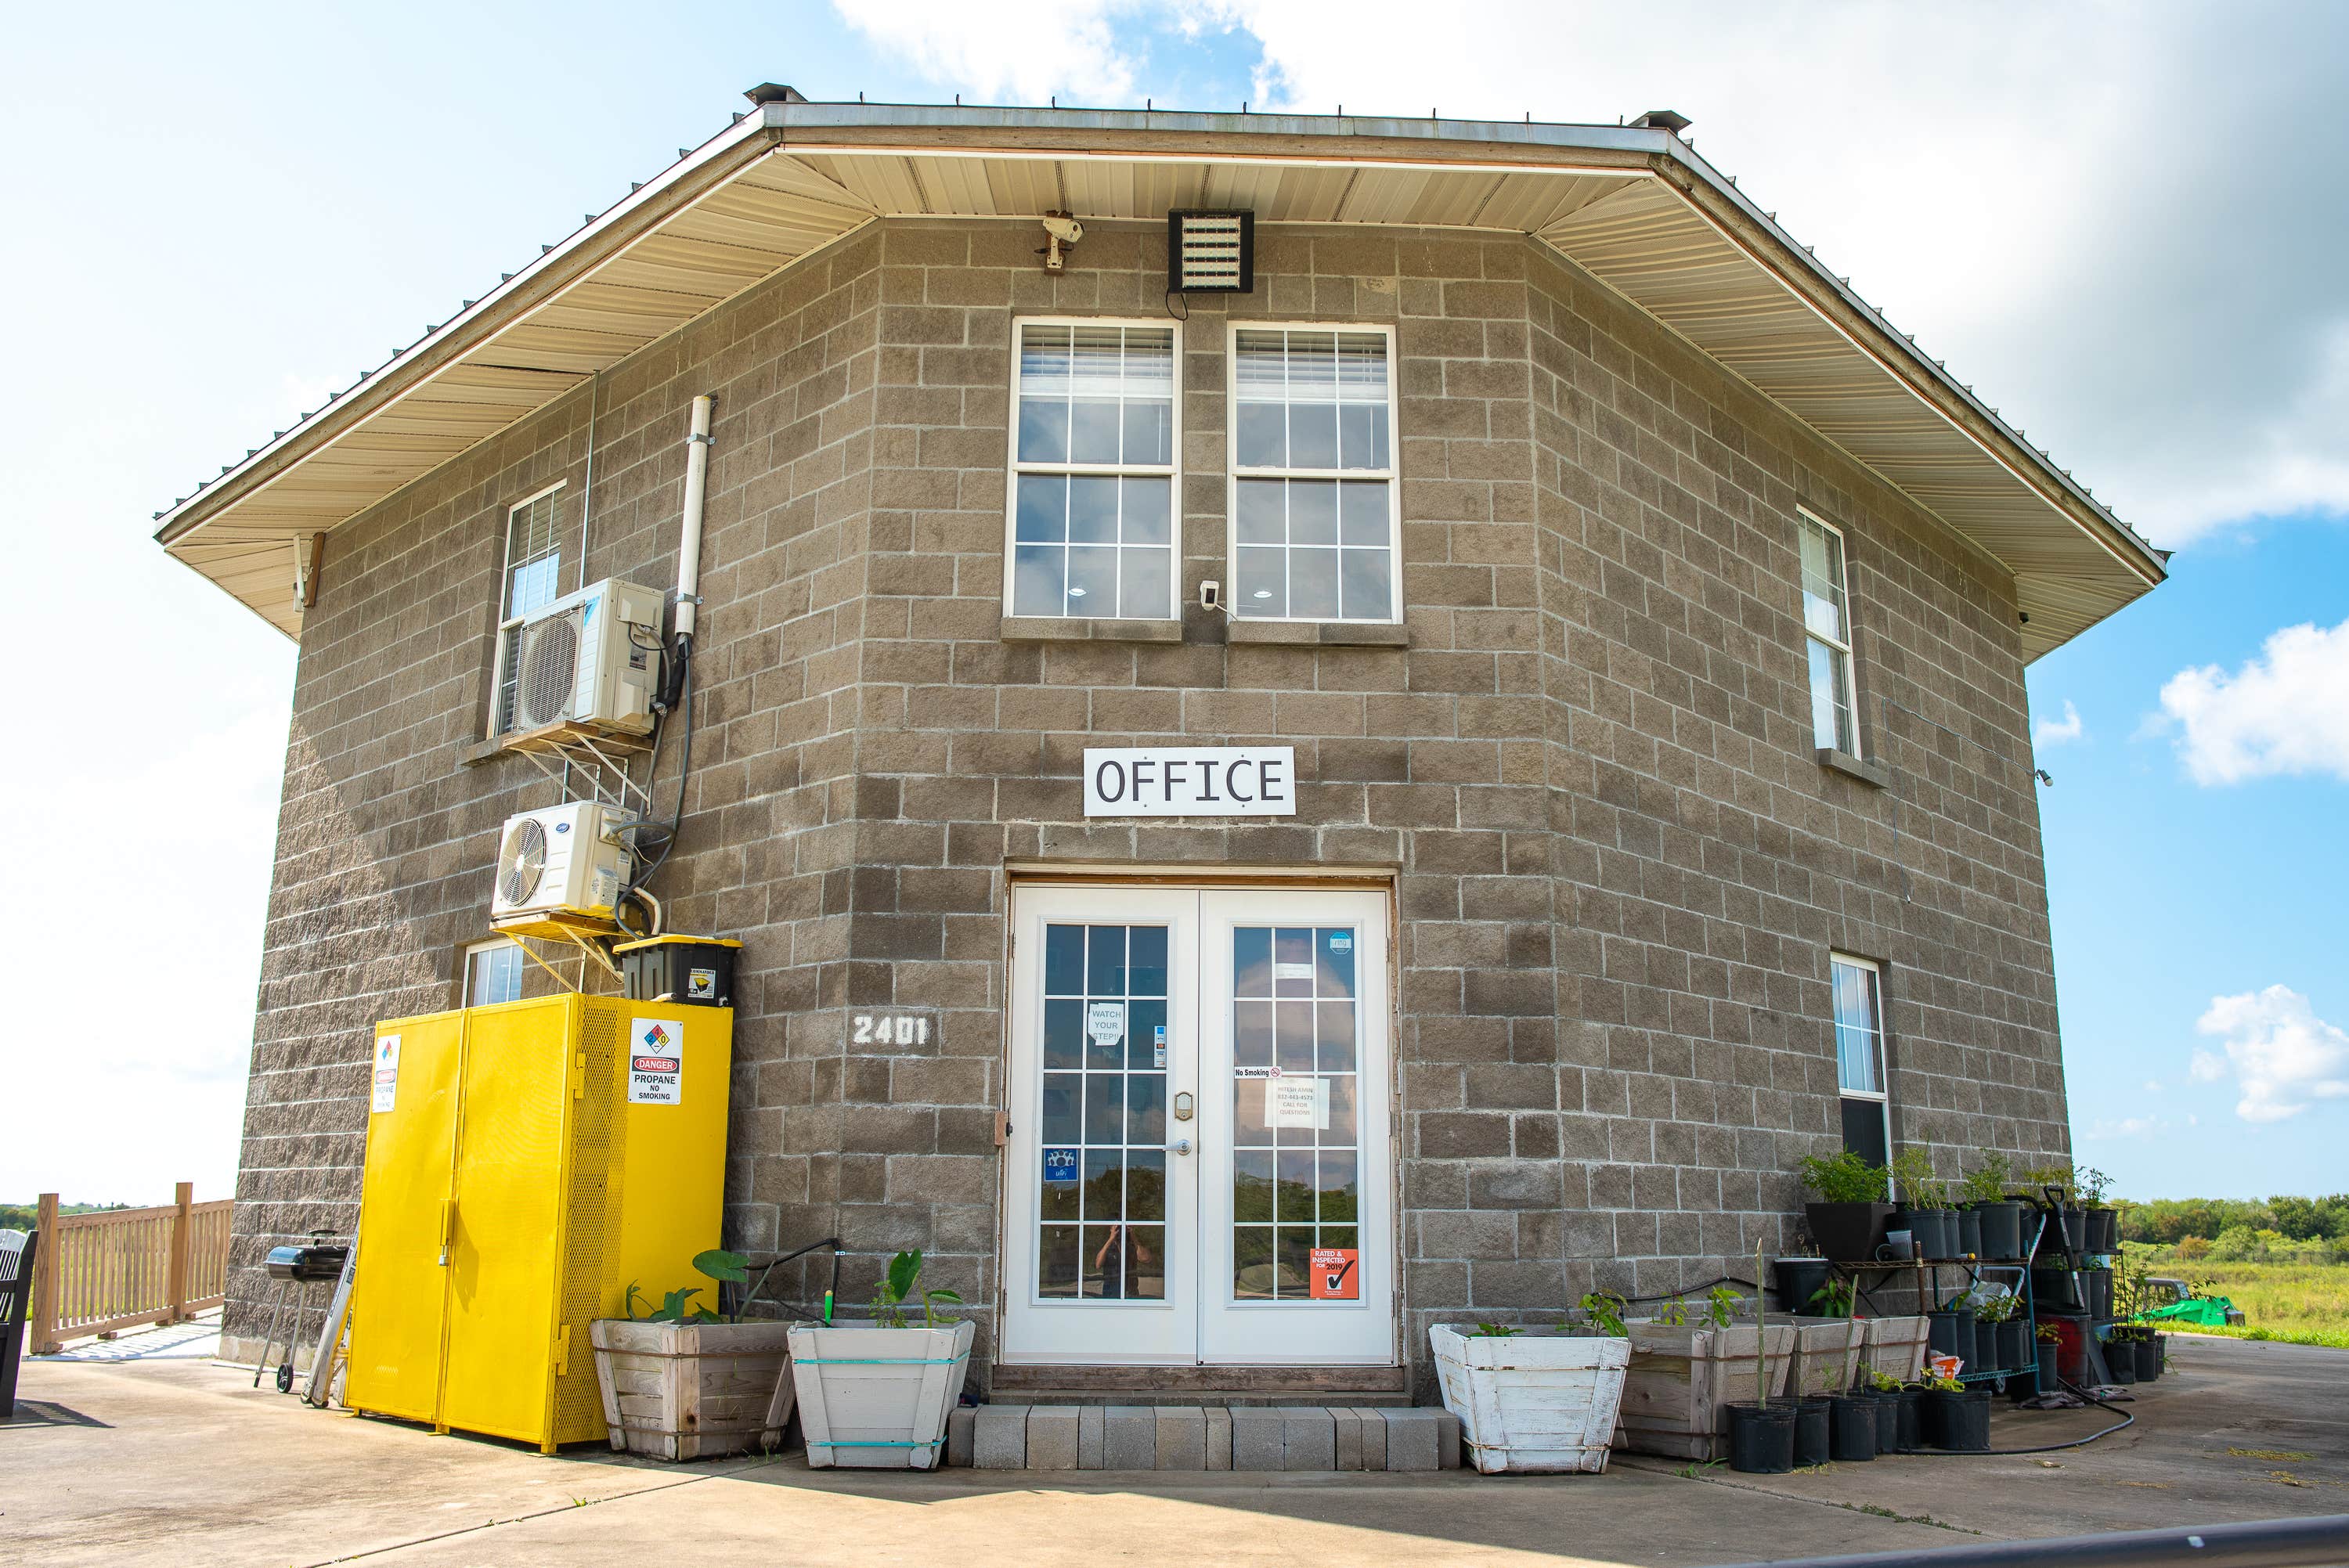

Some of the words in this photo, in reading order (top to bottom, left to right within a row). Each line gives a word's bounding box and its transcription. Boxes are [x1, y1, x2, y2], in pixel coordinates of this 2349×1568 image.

[1096, 760, 1283, 802] OFFICE
[853, 1015, 926, 1044] 2401
[639, 1060, 673, 1069] DANGER
[634, 1074, 676, 1084] PROPANE
